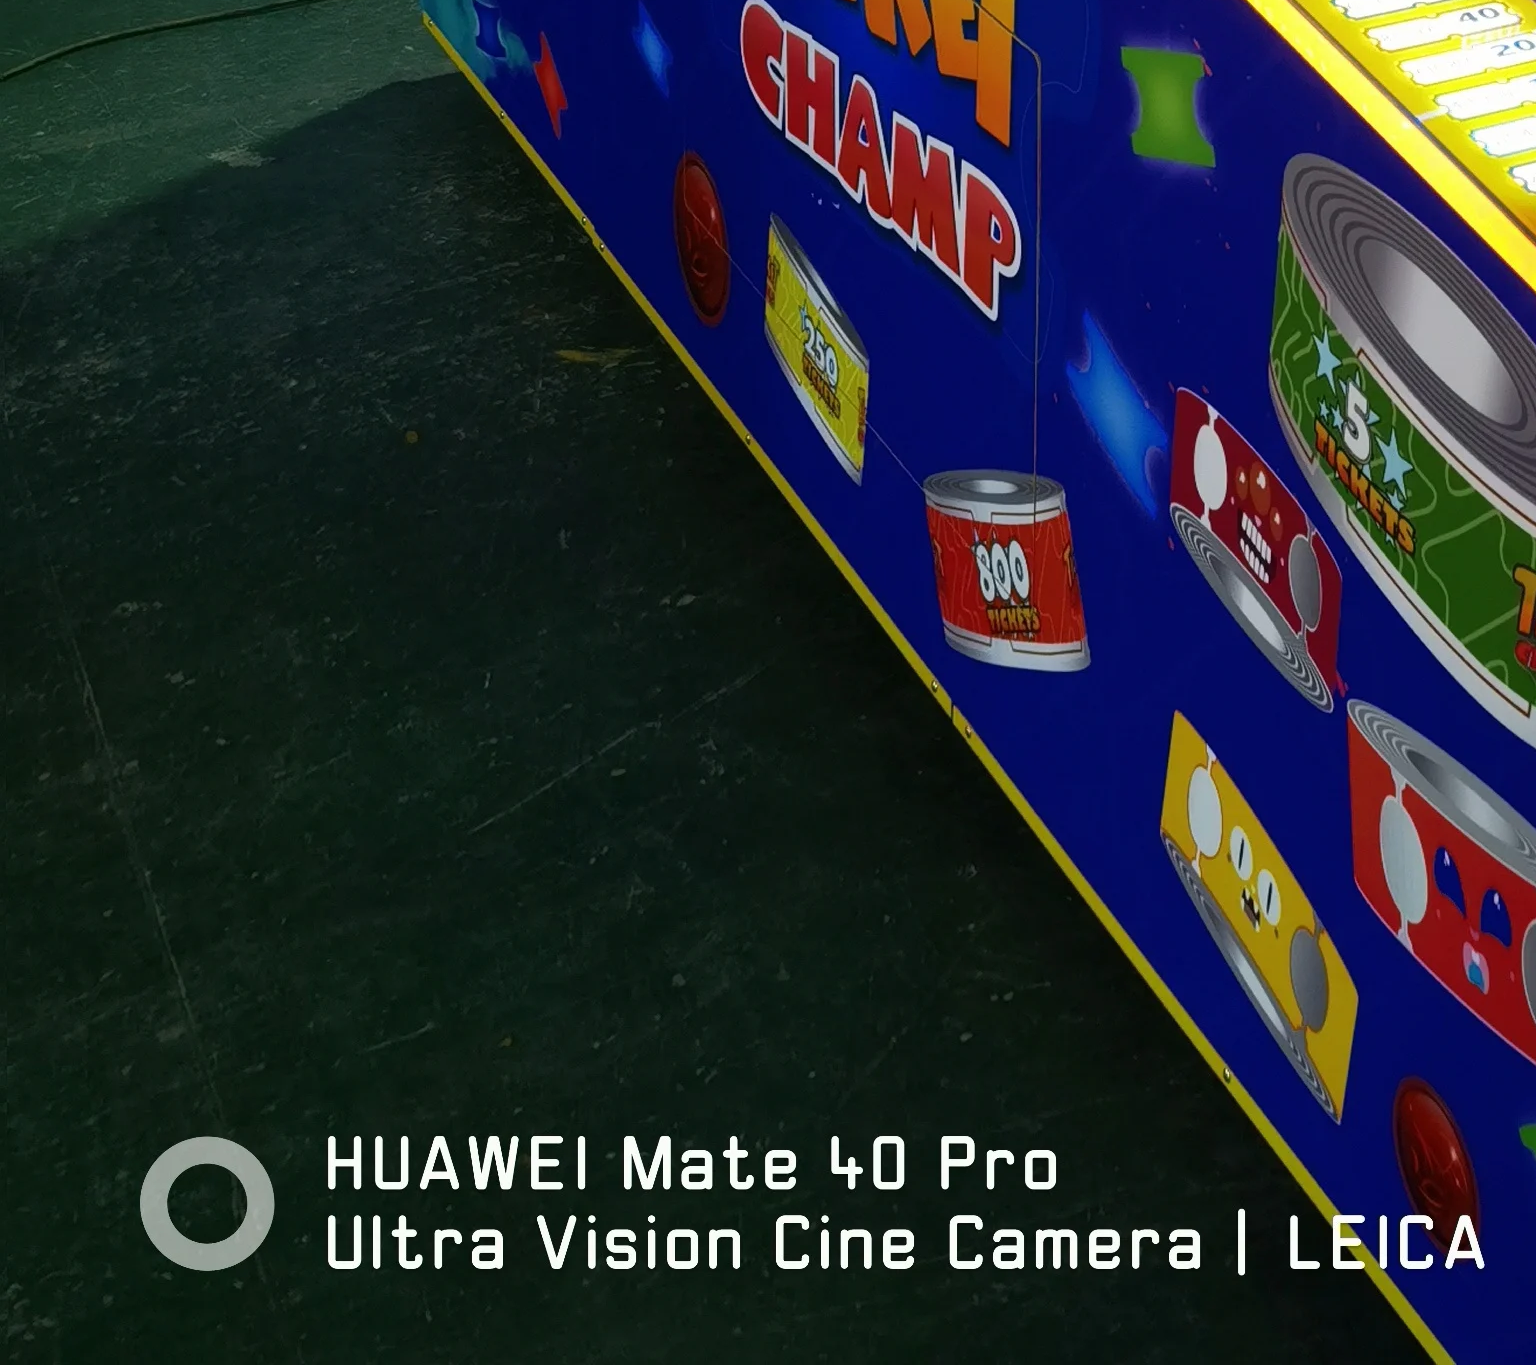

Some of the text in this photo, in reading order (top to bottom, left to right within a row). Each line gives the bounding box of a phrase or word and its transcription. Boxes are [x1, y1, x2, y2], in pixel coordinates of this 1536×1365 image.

[1459, 7, 1501, 25] 40
[1495, 39, 1536, 58] 20
[801, 313, 839, 388] 250
[1342, 379, 1372, 465] 5
[1313, 416, 1417, 555] TICKETS
[973, 538, 1031, 603] 800
[986, 604, 1041, 636] TICKETS
